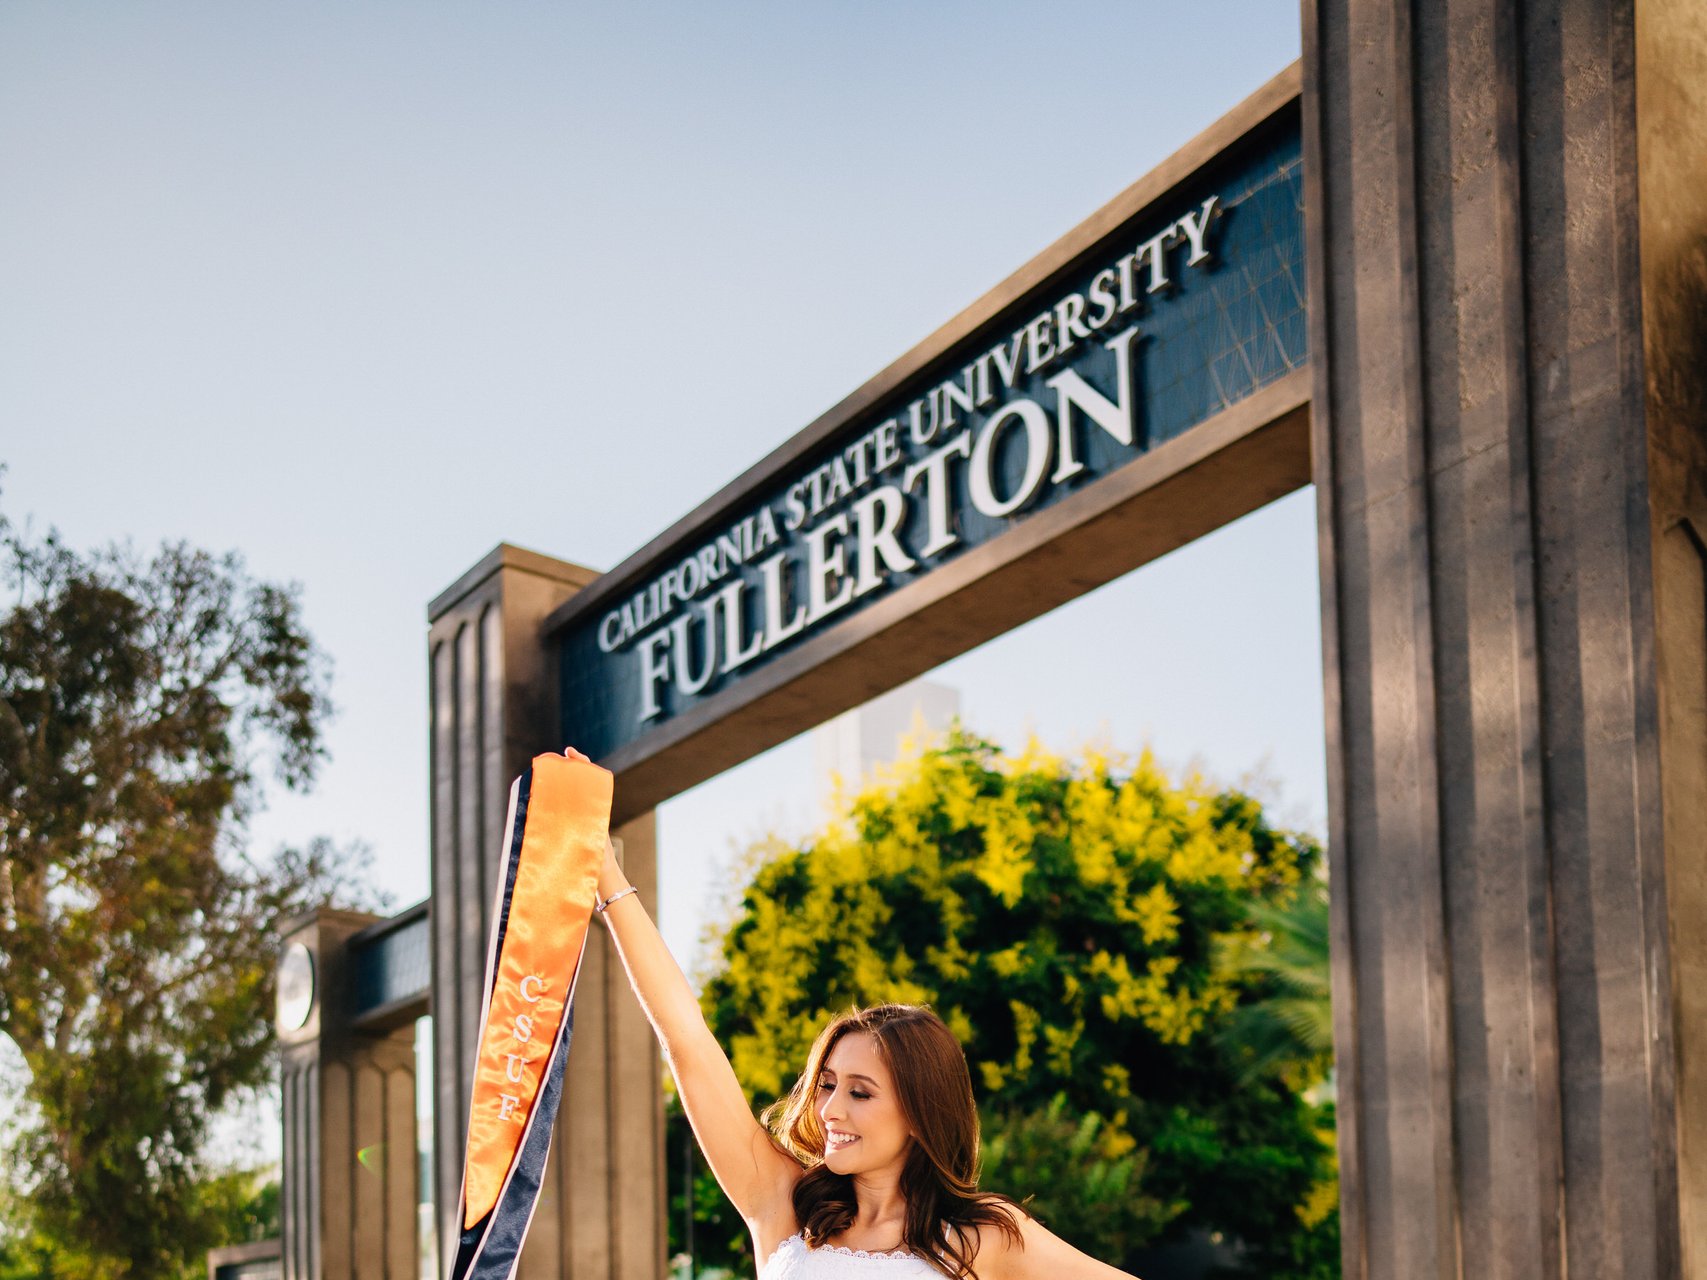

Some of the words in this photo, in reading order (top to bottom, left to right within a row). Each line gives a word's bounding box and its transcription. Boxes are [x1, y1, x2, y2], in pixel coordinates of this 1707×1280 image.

[598, 506, 779, 652] CALIFORNIA
[784, 419, 900, 531] STATE
[908, 195, 1218, 445] UNIVERSITY
[637, 326, 1139, 722] FULLERTON
[498, 975, 543, 1121] CSUF
